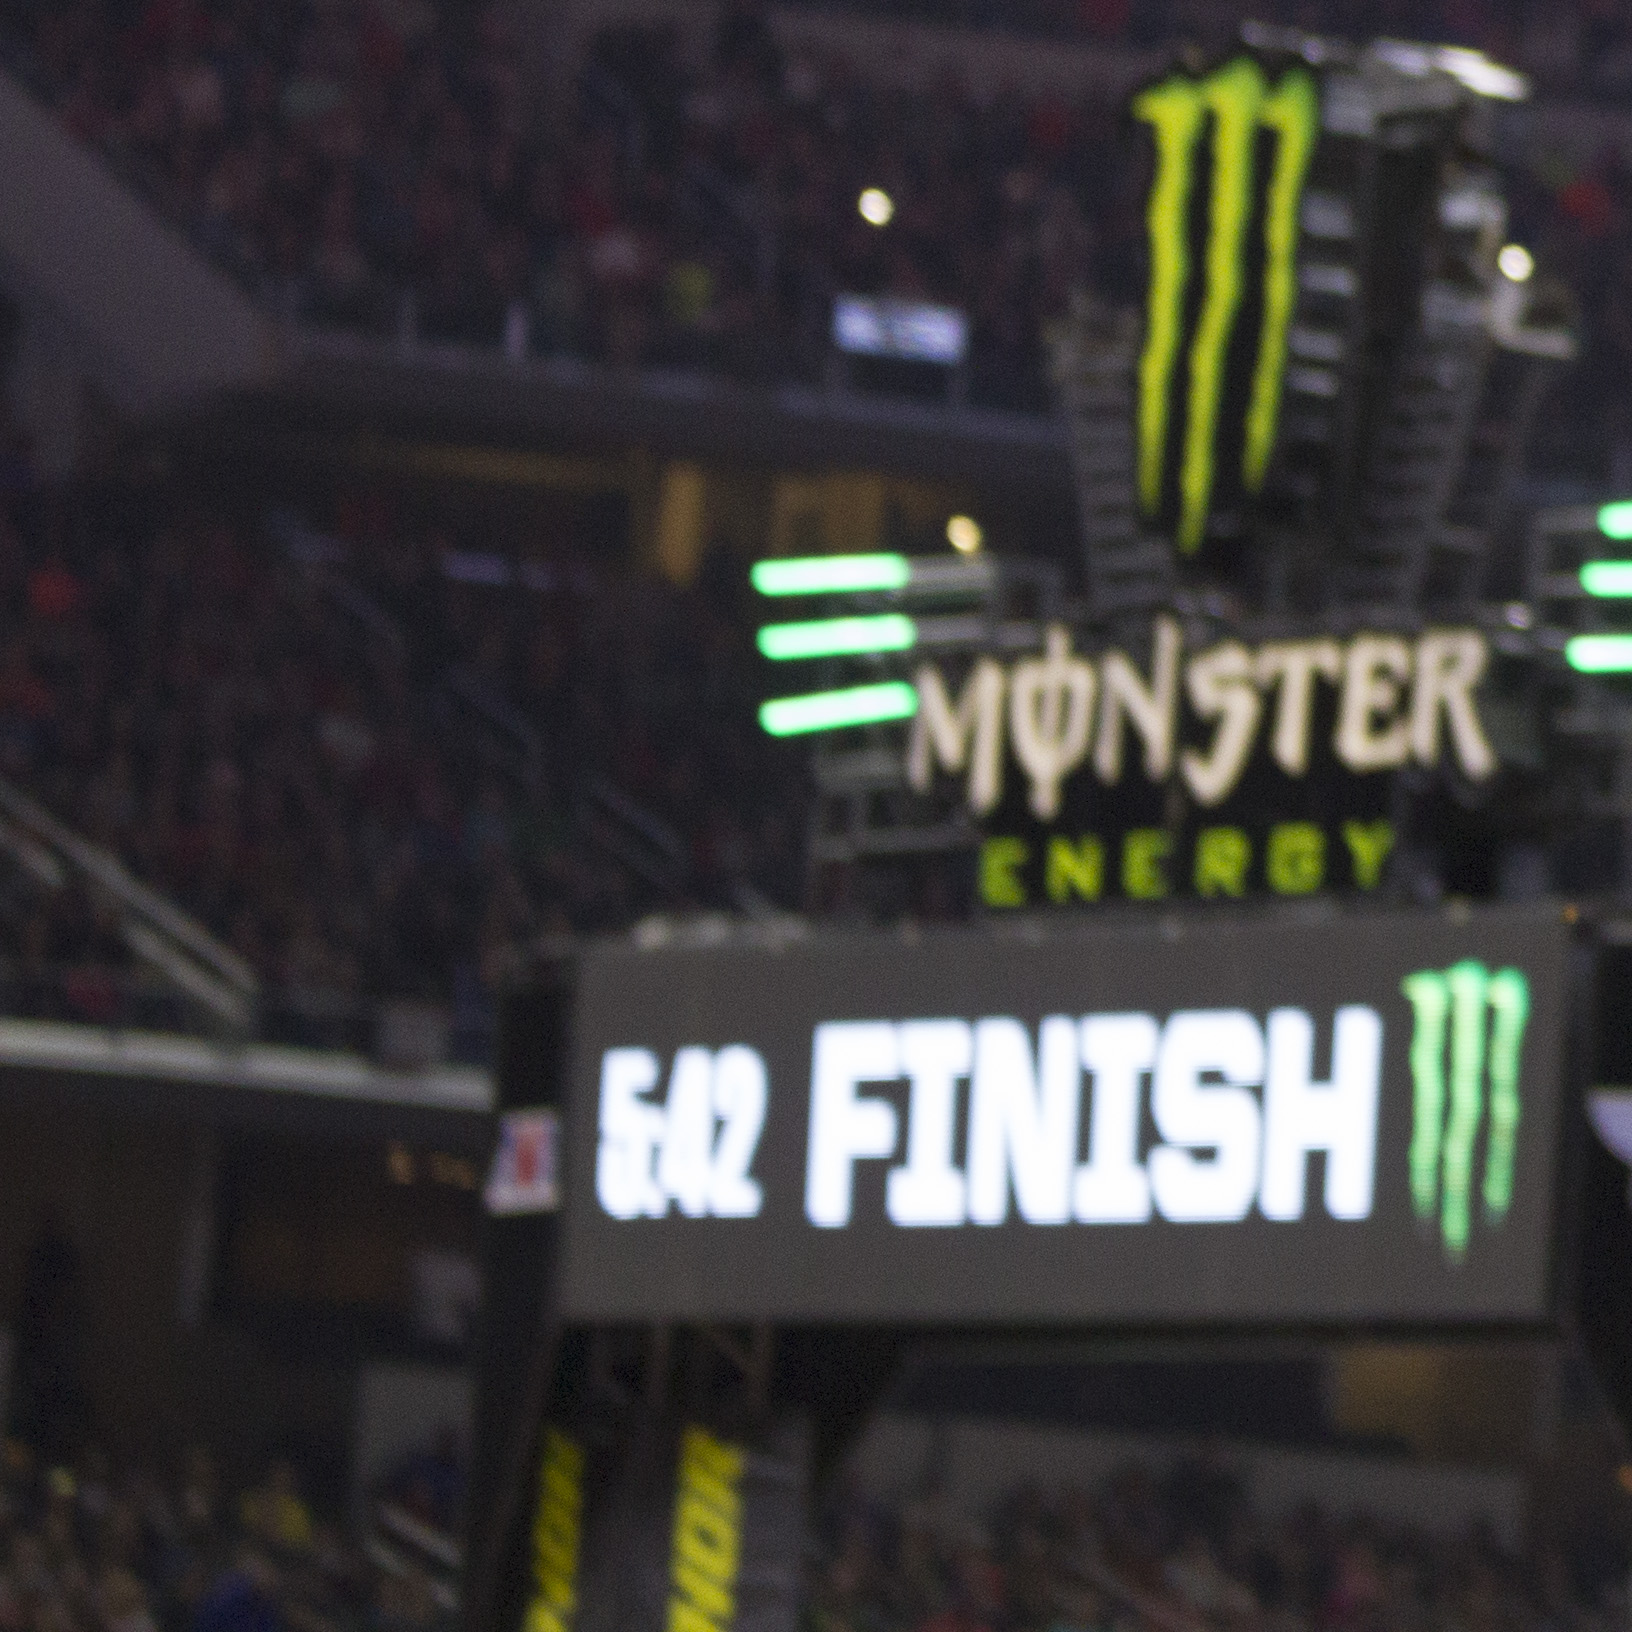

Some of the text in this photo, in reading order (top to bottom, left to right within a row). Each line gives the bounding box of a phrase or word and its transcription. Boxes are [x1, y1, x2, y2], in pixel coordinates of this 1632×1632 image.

[906, 614, 1497, 820] MONSTER
[979, 820, 1395, 908] ENERGY
[803, 1004, 1384, 1230] FINISH
